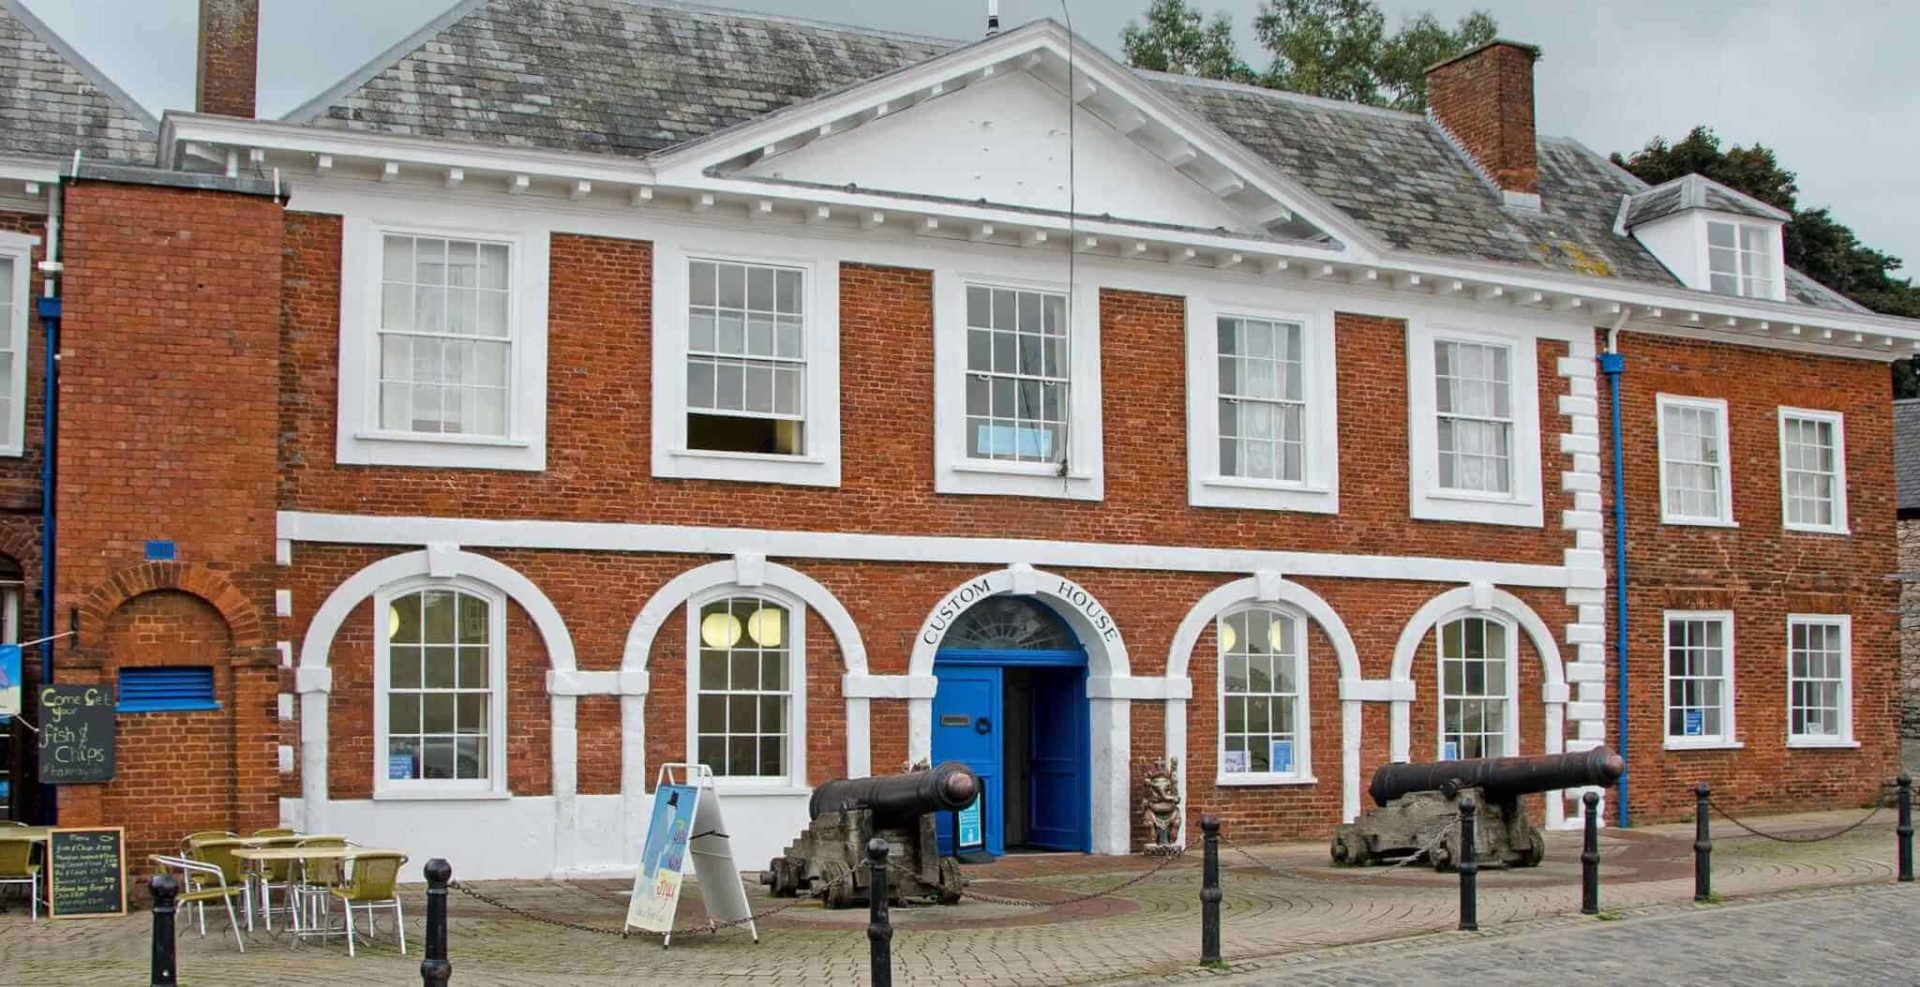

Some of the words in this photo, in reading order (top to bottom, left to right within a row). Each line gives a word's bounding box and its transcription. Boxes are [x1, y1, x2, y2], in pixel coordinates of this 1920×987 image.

[923, 579, 991, 645] CUSTOM
[1058, 581, 1118, 642] HOUSE
[41, 688, 81, 707] Come
[84, 688, 112, 706] Get
[51, 707, 78, 722] your
[39, 723, 75, 748] fish
[55, 745, 105, 765] Chips
